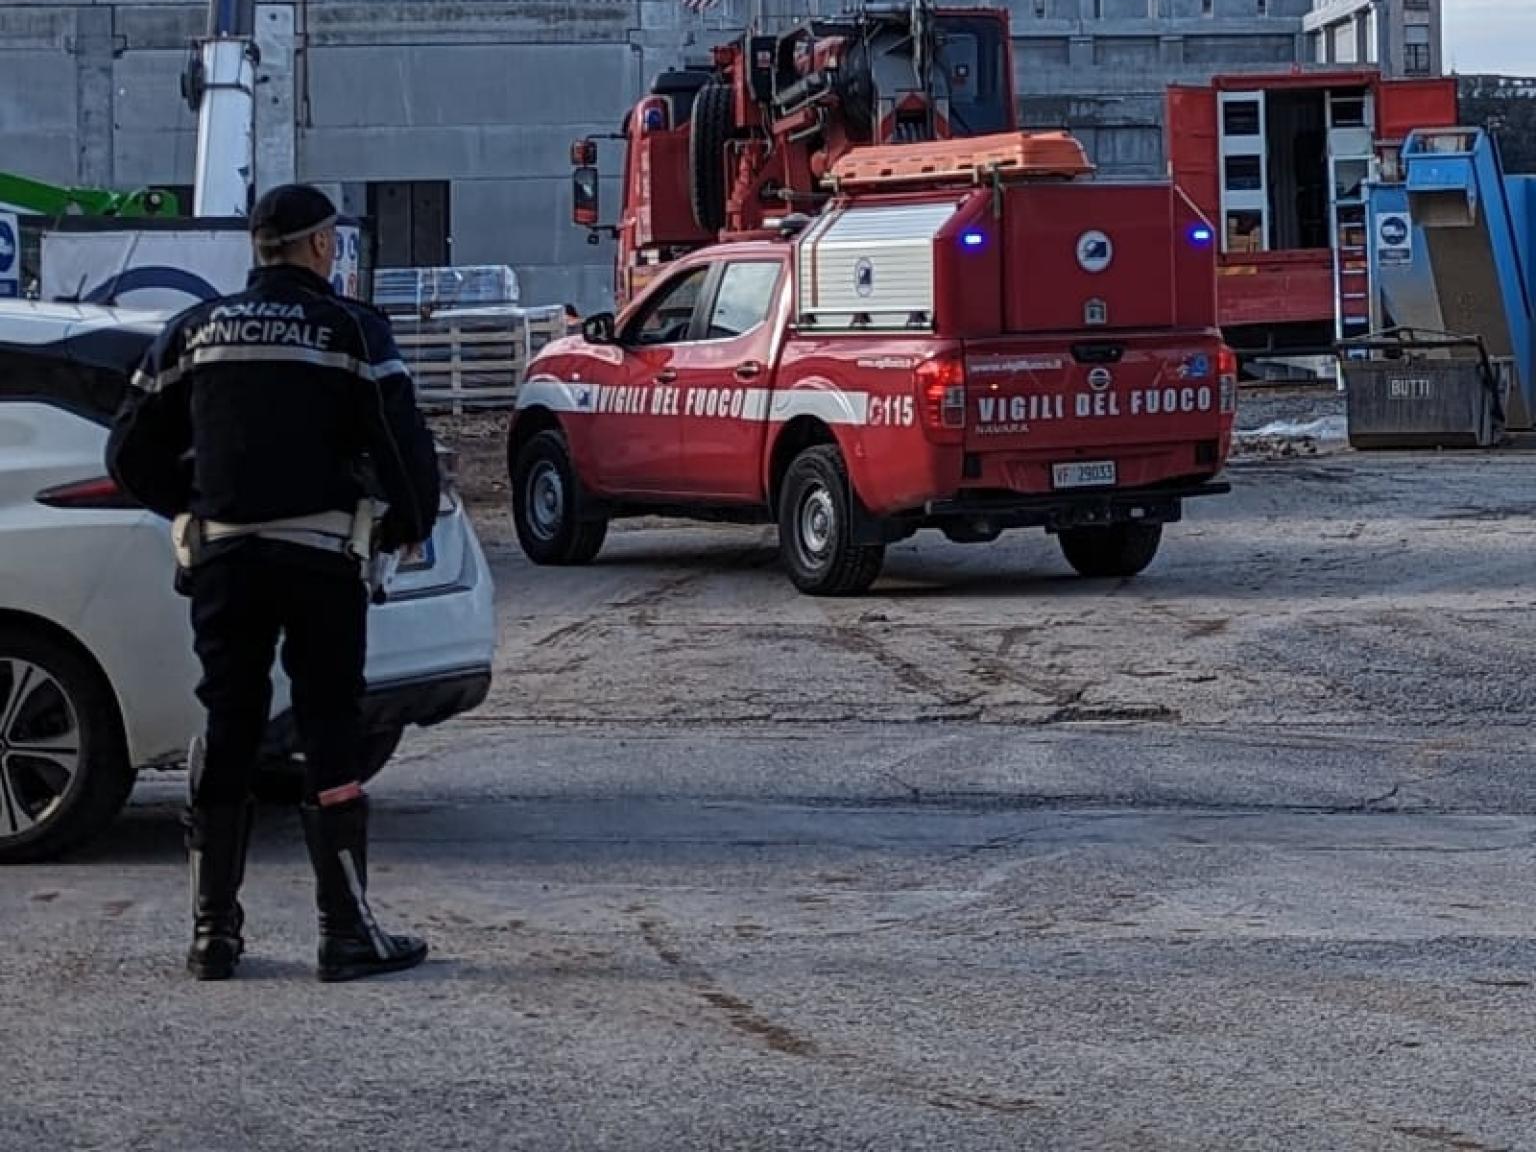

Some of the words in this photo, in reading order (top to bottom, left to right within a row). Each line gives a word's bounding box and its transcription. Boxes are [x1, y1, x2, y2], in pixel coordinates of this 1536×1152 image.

[185, 321, 333, 348] MUNICIPALE
[599, 385, 647, 414] VIGILI
[651, 386, 680, 415] DEL
[684, 387, 743, 417] FUOCO
[1391, 379, 1429, 396] BUTTI
[884, 395, 914, 427] 115
[978, 394, 1064, 423] VIGILI
[1075, 392, 1121, 417] DEL
[1130, 386, 1211, 415] FUOCO
